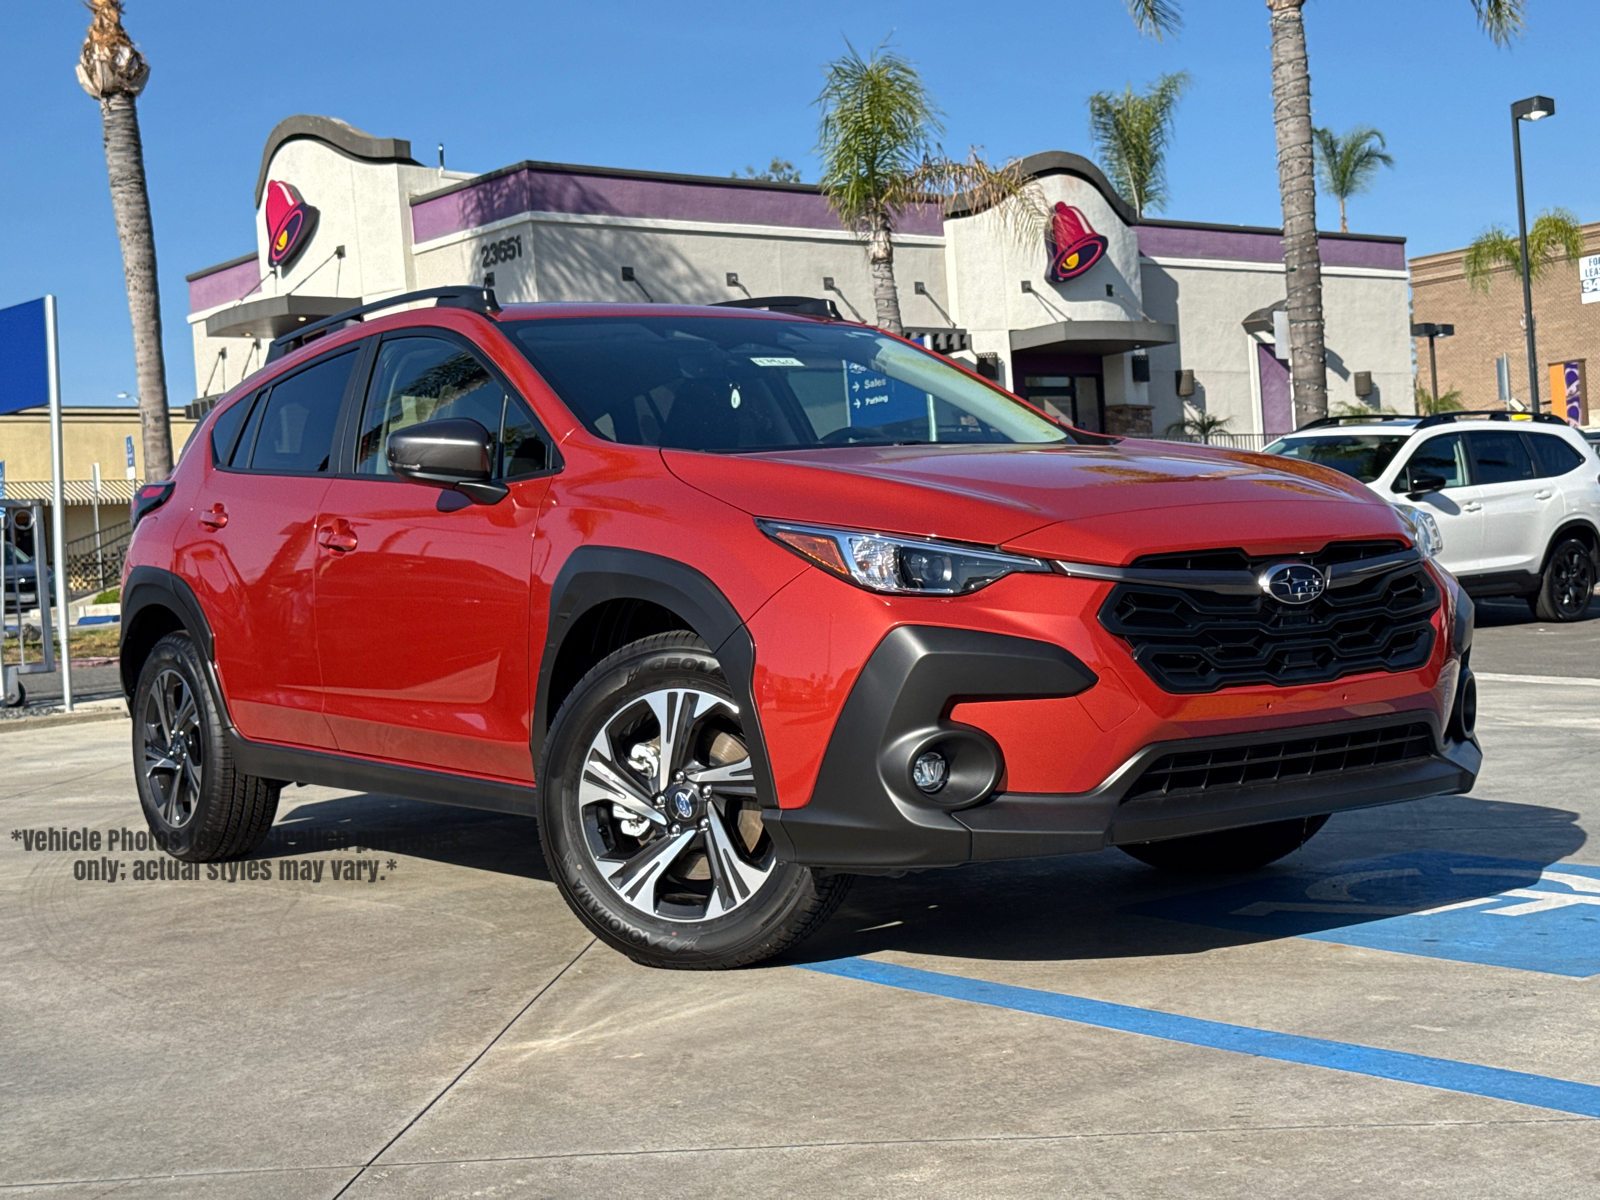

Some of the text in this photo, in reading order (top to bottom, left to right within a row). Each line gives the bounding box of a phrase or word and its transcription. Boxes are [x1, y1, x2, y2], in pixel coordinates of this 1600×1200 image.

[481, 234, 523, 268] 23651
[864, 378, 887, 390] Sales
[865, 395, 889, 406] Parking
[572, 877, 651, 948] YOKOHAMA
